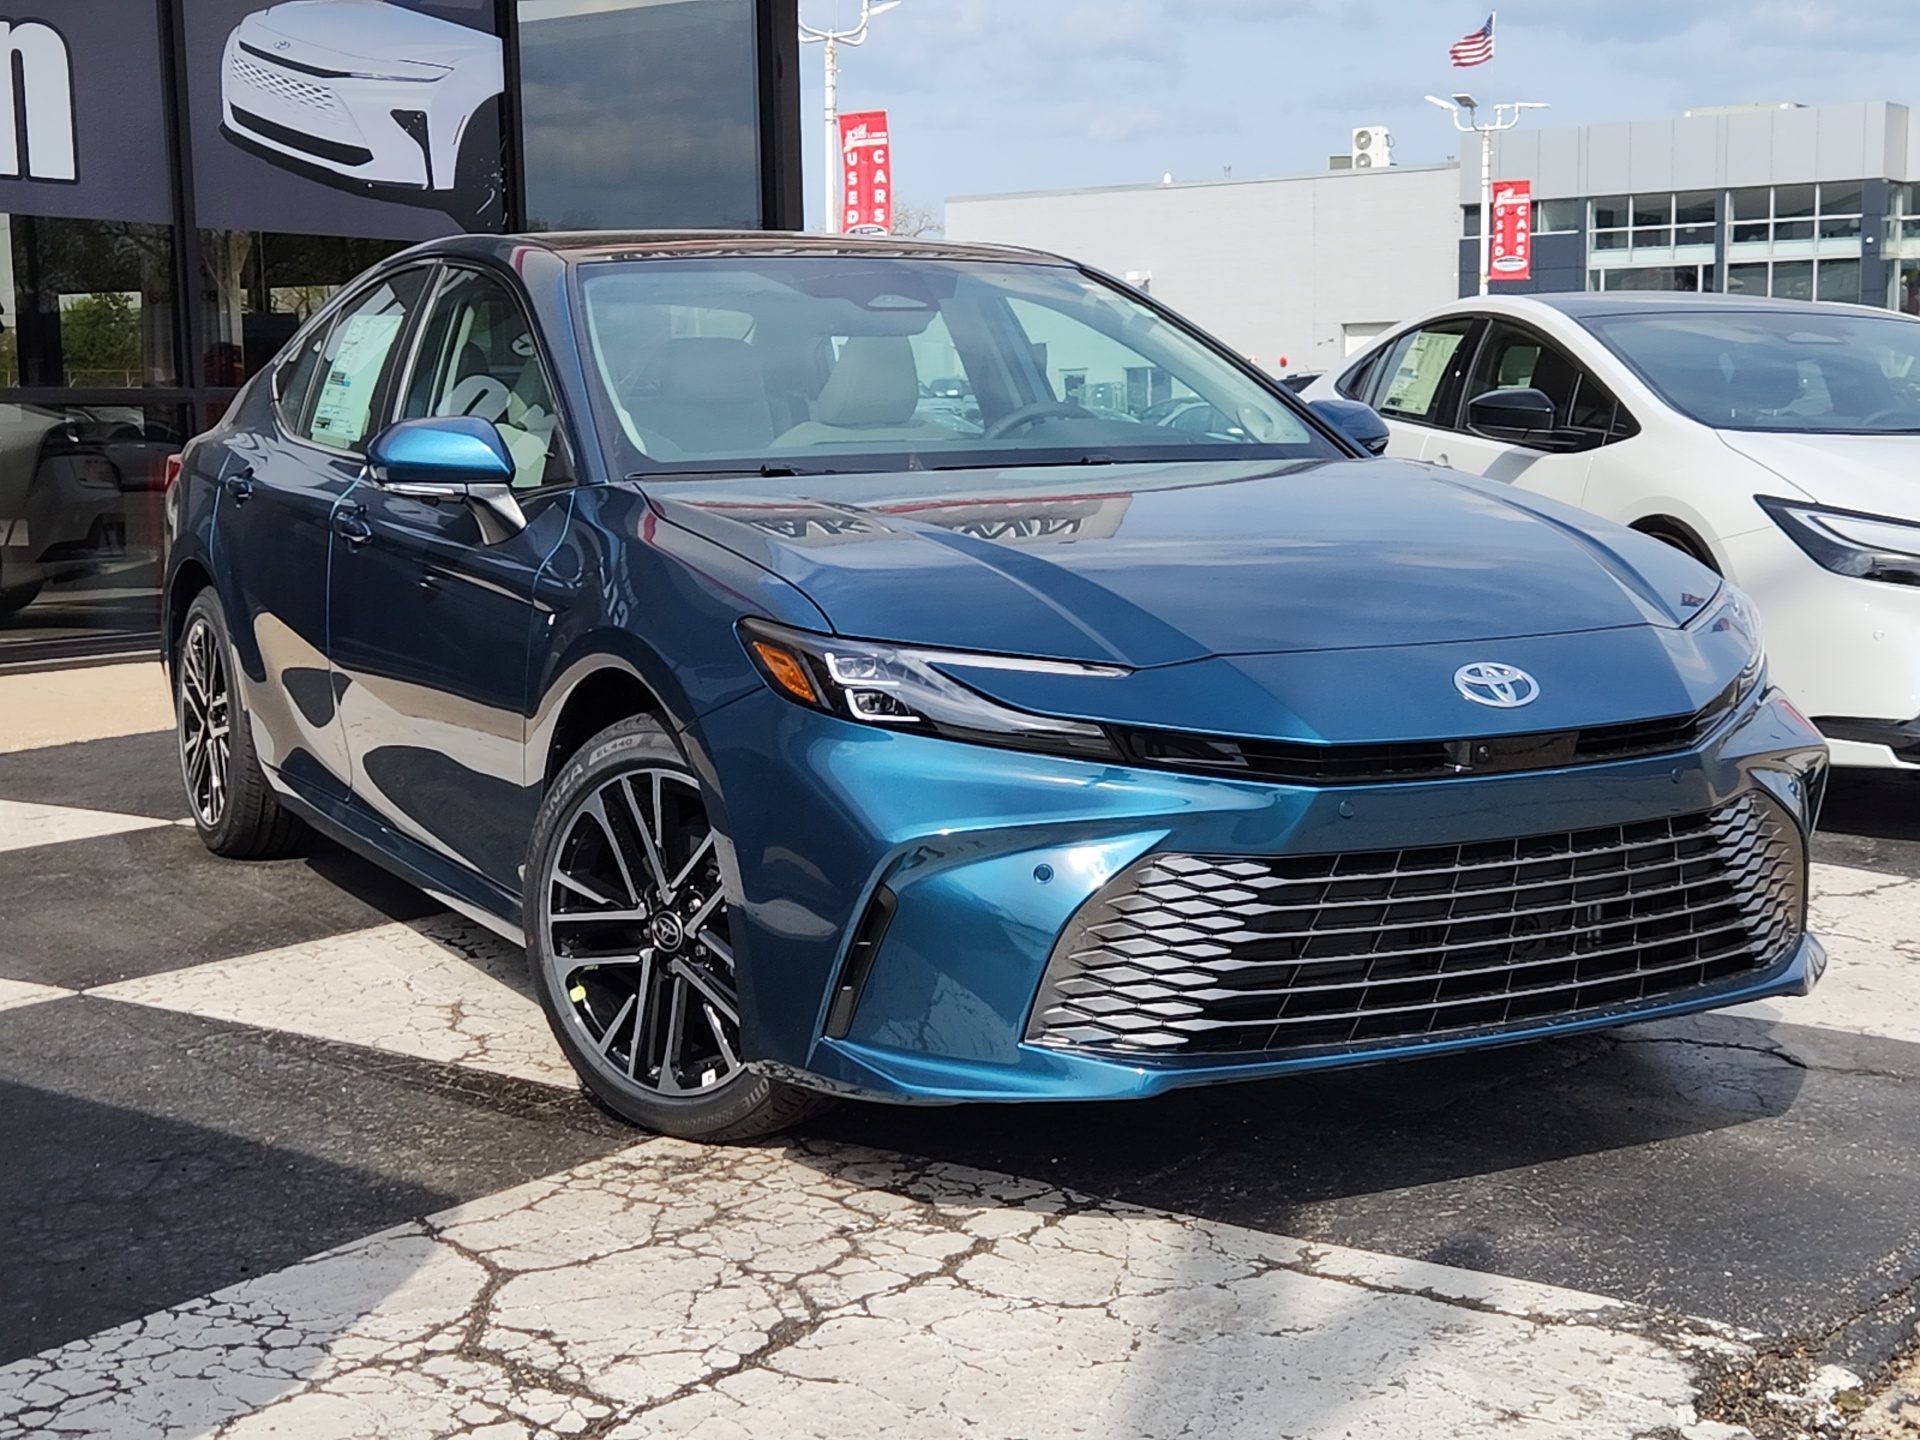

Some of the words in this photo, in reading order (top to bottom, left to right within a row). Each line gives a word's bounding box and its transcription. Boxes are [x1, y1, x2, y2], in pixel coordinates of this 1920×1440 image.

[847, 151, 859, 224] USED
[873, 149, 887, 222] CARS
[1495, 206, 1505, 256] USED
[1516, 206, 1527, 256] CARS
